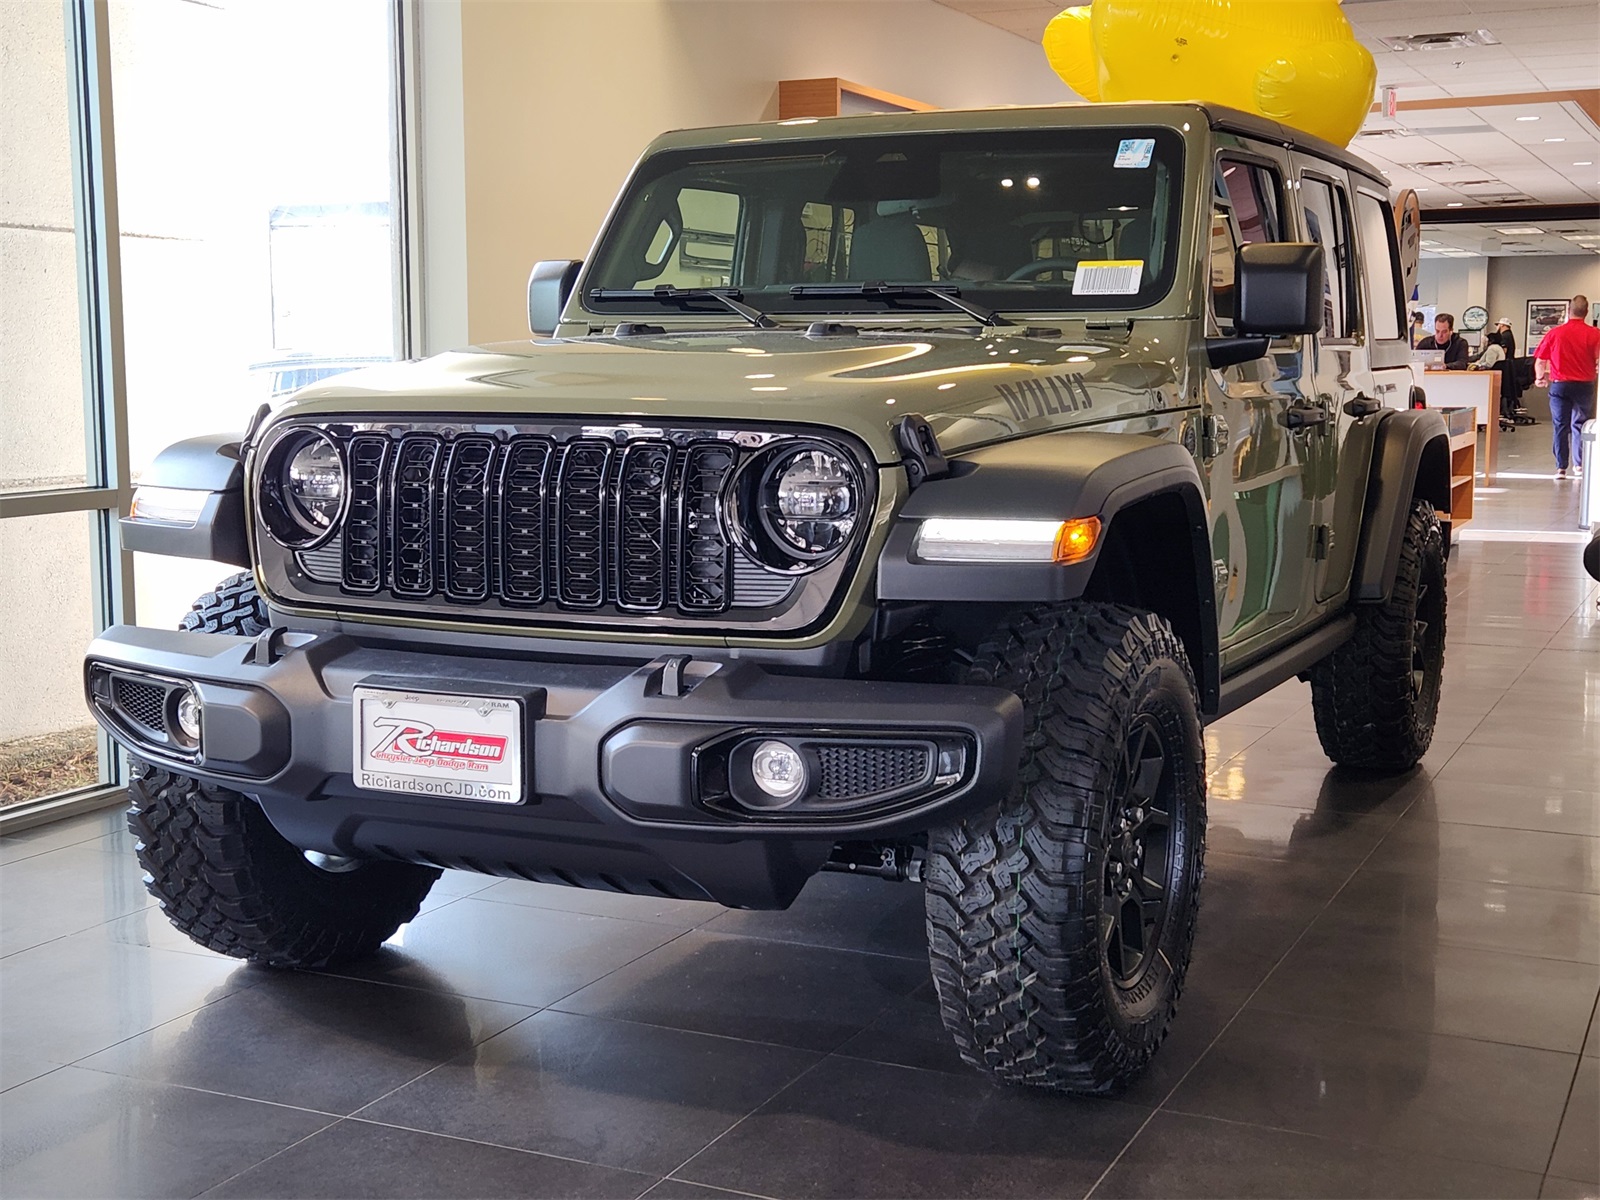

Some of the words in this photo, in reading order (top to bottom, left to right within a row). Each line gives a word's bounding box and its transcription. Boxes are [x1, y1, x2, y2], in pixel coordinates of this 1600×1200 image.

[404, 694, 420, 702] Jeep
[371, 717, 501, 758] Richardson
[375, 751, 412, 763] Chrysler
[414, 757, 434, 768] Jeep
[437, 758, 466, 770] Dodge
[468, 761, 489, 772] Ram
[361, 773, 511, 800] RichardsonCJD.com
